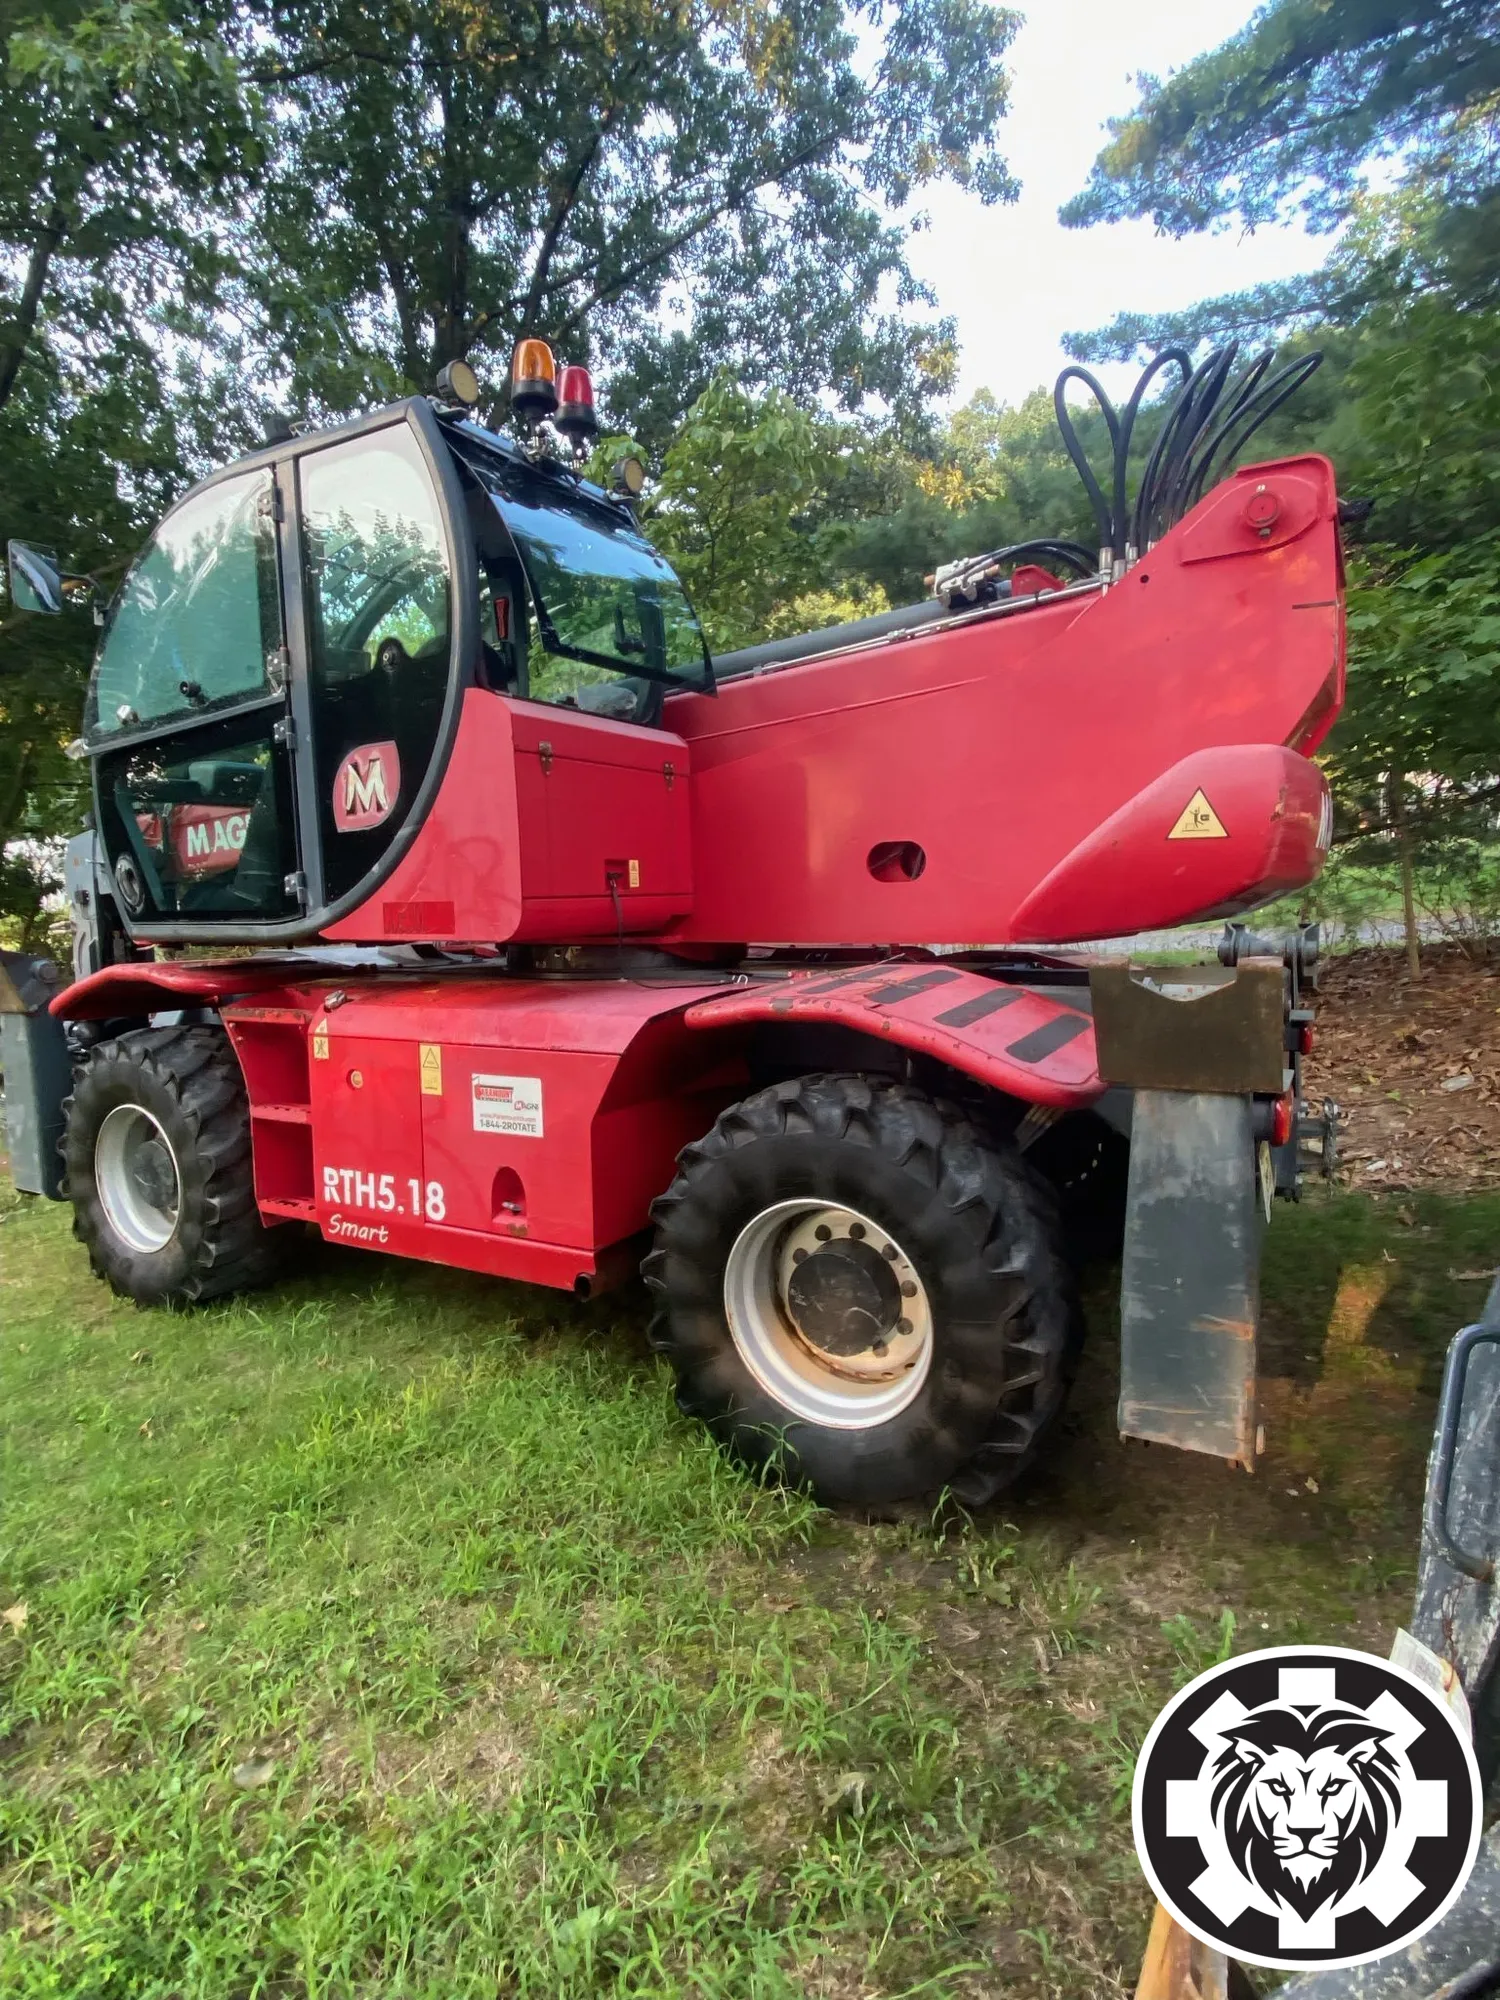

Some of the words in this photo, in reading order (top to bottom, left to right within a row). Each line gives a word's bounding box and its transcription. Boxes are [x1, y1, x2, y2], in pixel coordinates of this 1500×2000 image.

[345, 758, 389, 816] M
[187, 813, 251, 857] MAG
[480, 1119, 537, 1132] 1-844-2ROTATE
[323, 1166, 446, 1221] RTH5.18
[328, 1213, 389, 1243] Smart
